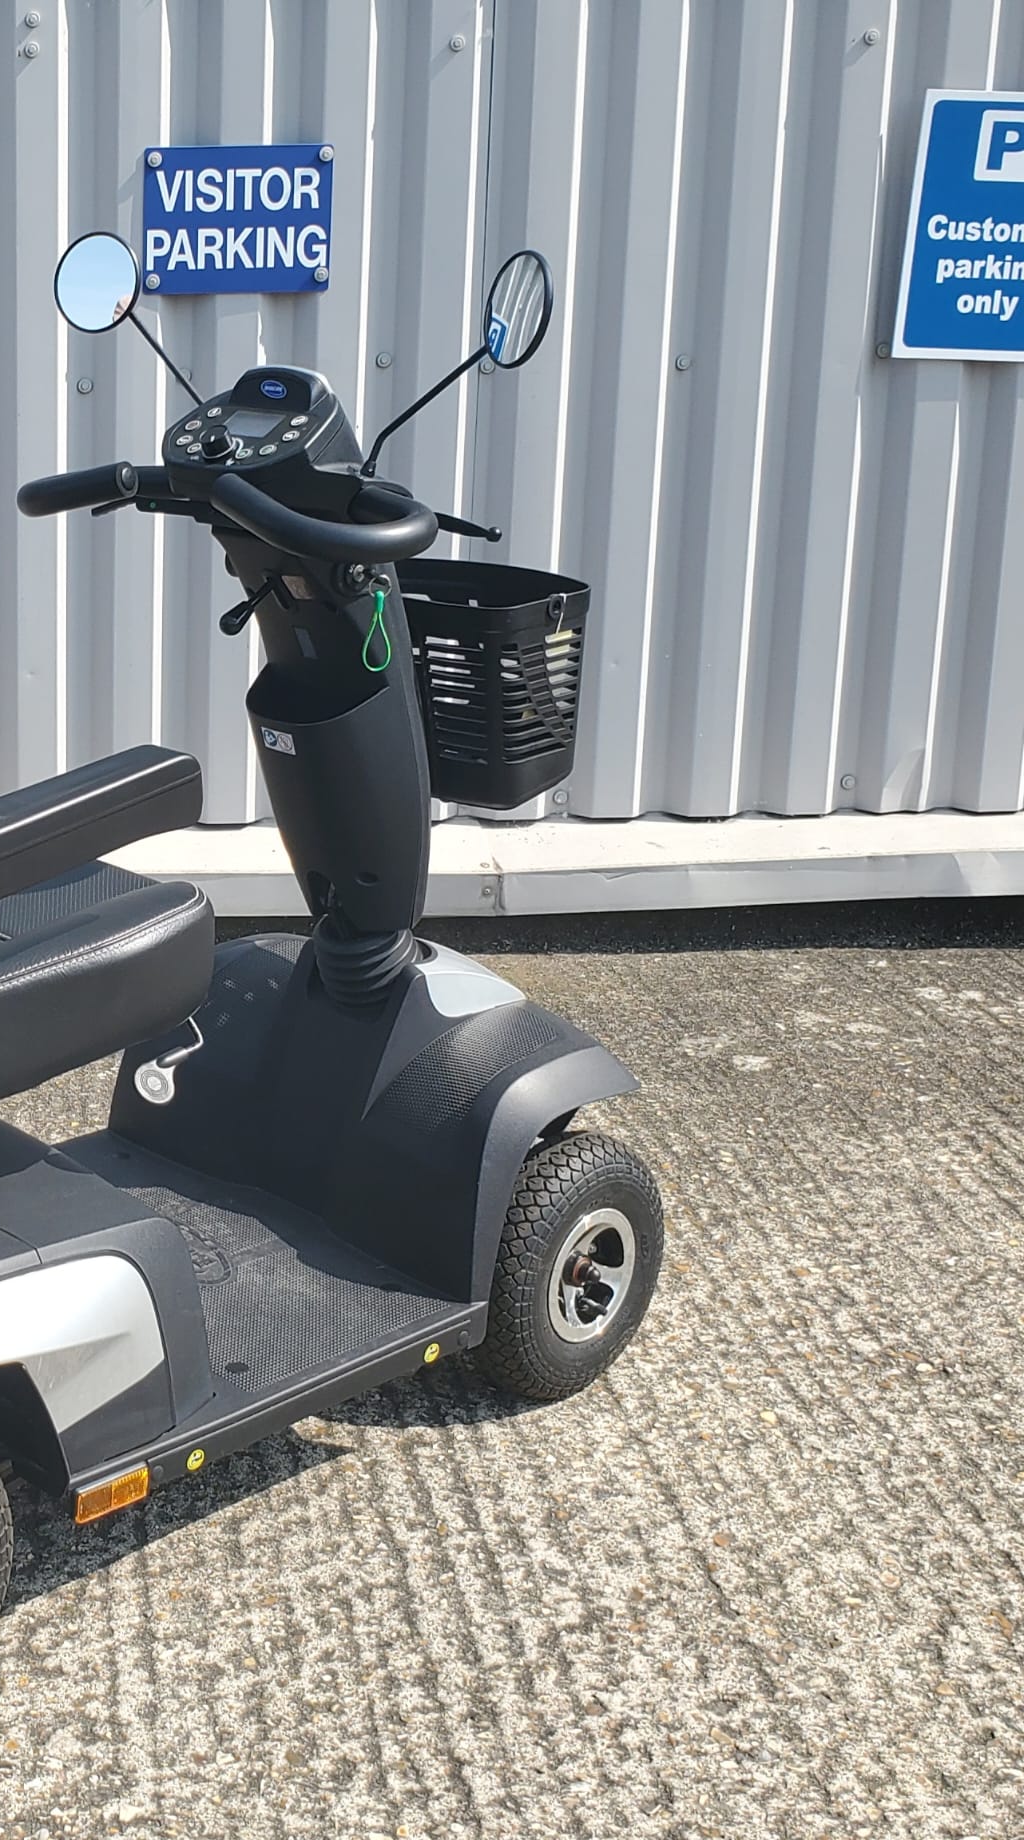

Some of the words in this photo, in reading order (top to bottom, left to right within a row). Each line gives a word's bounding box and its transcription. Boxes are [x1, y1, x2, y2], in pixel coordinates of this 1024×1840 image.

[986, 121, 1024, 171] P
[156, 167, 321, 213] VISITOR
[146, 224, 328, 271] PARKING
[956, 289, 1020, 321] only
